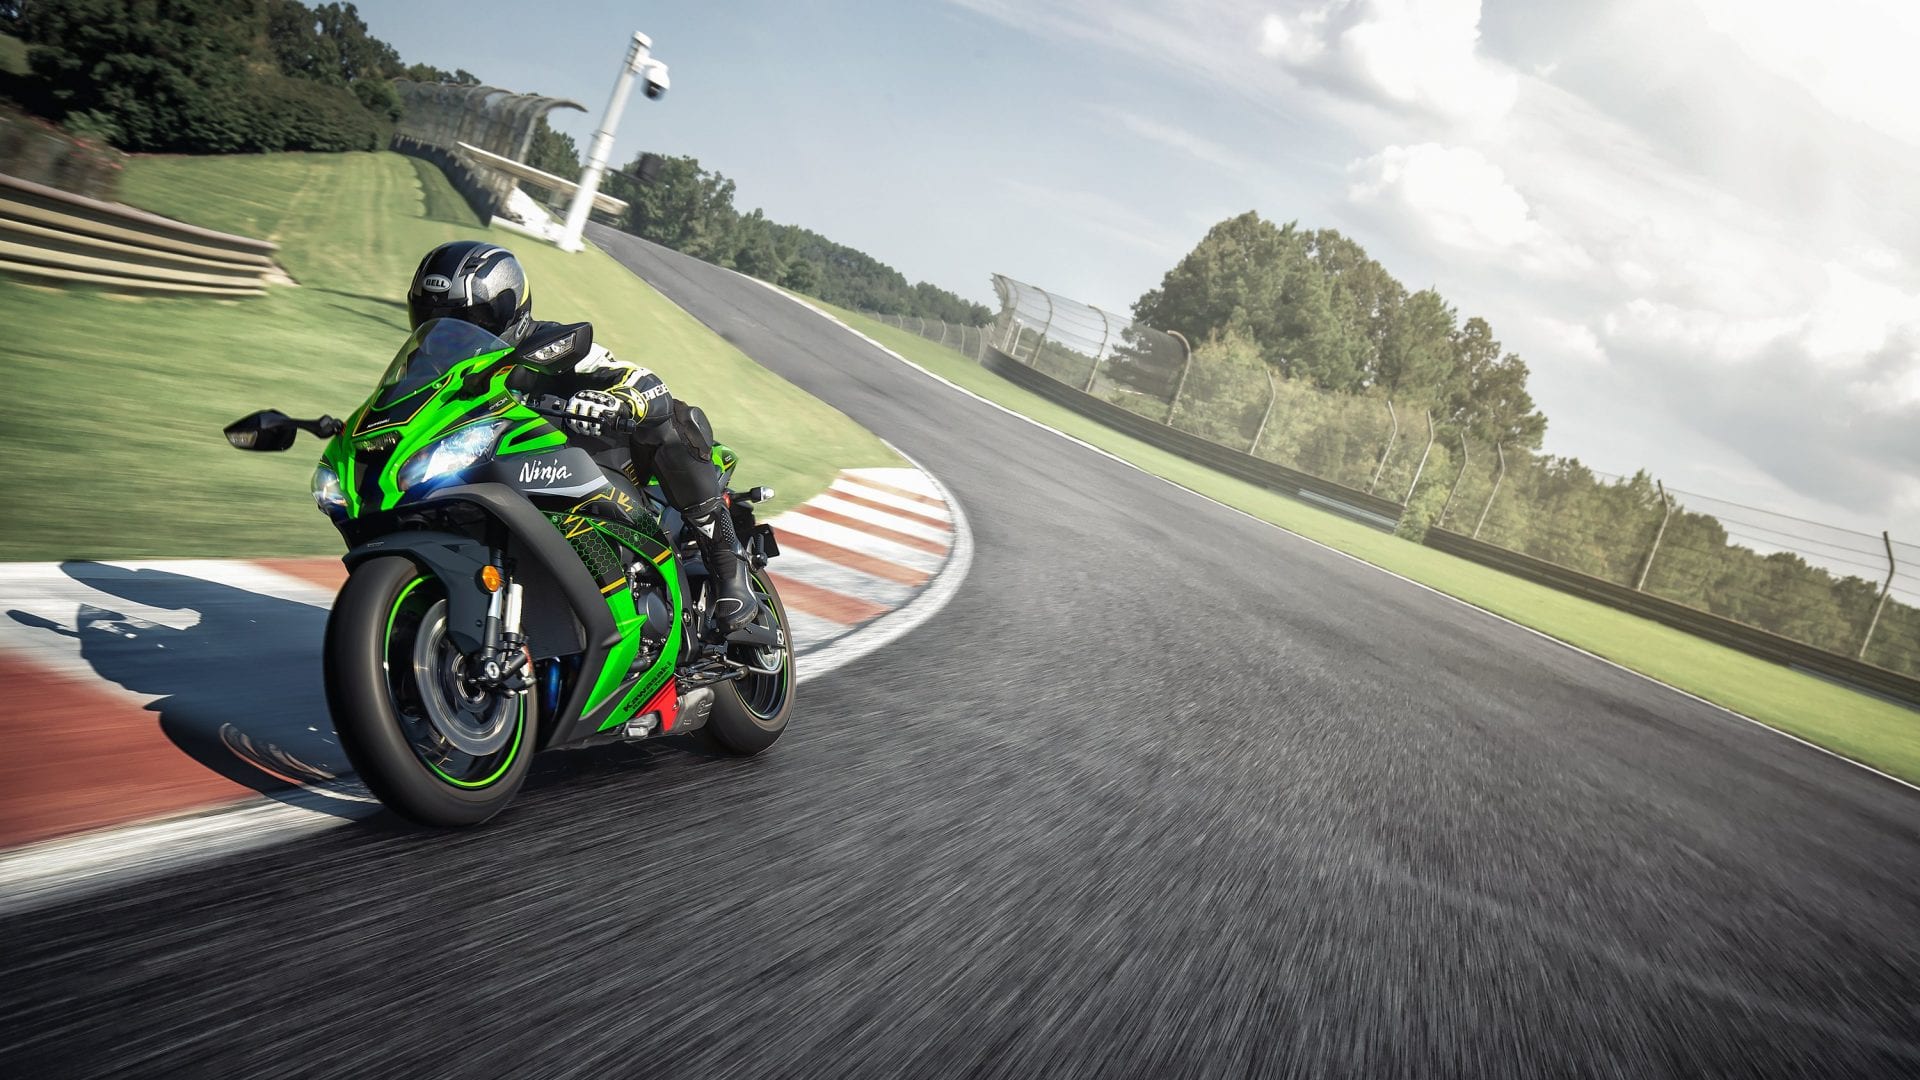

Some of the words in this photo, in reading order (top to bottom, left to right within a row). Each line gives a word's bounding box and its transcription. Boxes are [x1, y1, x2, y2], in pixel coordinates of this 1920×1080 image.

[425, 278, 446, 288] BELL
[519, 459, 573, 487] Ninja
[623, 660, 673, 713] Kawasaki
